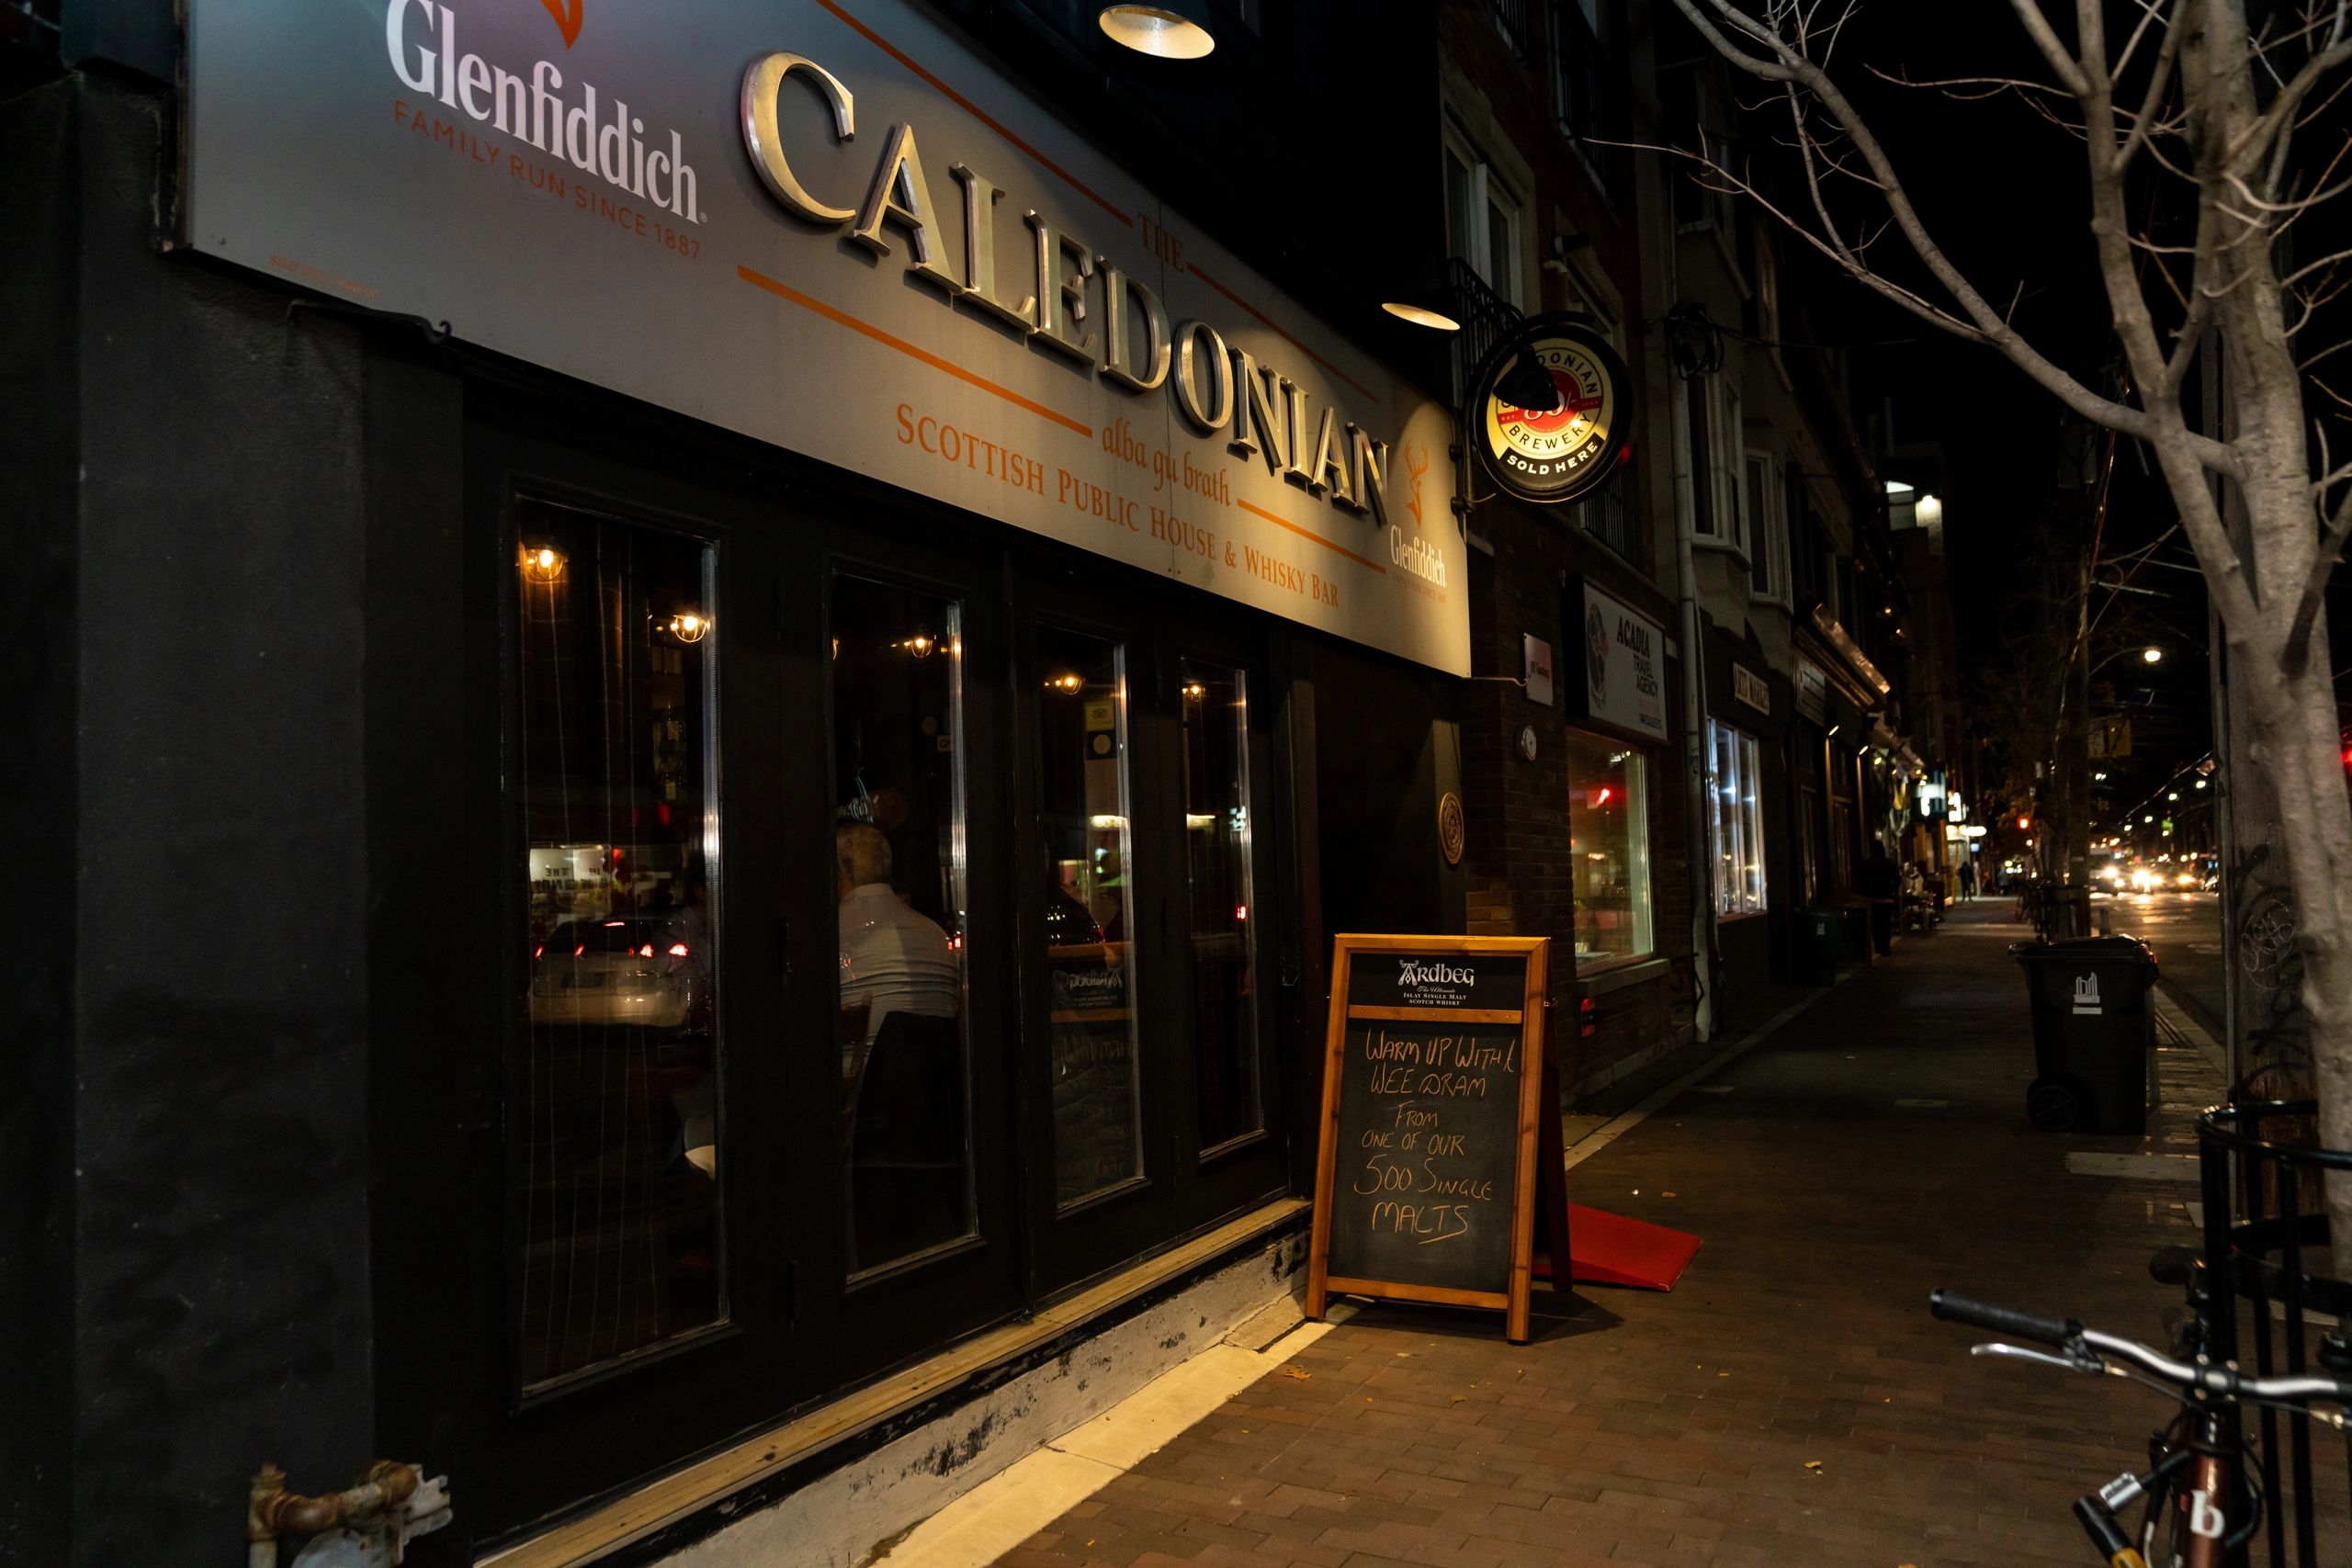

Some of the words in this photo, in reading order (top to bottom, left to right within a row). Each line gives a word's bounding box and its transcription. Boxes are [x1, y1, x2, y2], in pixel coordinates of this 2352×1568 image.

[386, 0, 700, 225] Glenfiddich
[393, 99, 501, 167] FAMILY
[510, 154, 565, 199] RUN
[574, 186, 648, 237] SINCE
[653, 223, 702, 260] 1887
[1137, 211, 1185, 274] THE
[741, 51, 1390, 521] CALEDONIAN
[1509, 413, 1592, 450] BREWERY
[1102, 416, 1148, 470] alba
[1153, 449, 1180, 492] gu
[1183, 450, 1232, 507] brath
[1507, 454, 1550, 475] SOLD
[1555, 441, 1600, 473] HERE
[896, 402, 1046, 497] SCOTTISH
[1057, 468, 1140, 533] PUBLIC
[1148, 504, 1216, 560] HOUSE
[1224, 539, 1238, 569] &
[1243, 544, 1306, 595] WHISKY
[1311, 572, 1340, 609] BAR
[1389, 524, 1447, 589] Glenfiddich
[1616, 615, 1651, 660] ACADIA
[1397, 958, 1476, 987] Ardbeg
[1365, 1028, 1420, 1064] WARM
[1425, 1036, 1453, 1066] UP
[1454, 1033, 1502, 1070] WITH
[1371, 1062, 1415, 1095] WEE
[1419, 1072, 1487, 1098] DRAM
[1395, 1100, 1439, 1128] FROM
[1362, 1129, 1395, 1148] ONE
[1401, 1131, 1422, 1150] OF
[1428, 1134, 1465, 1156] OUR
[1353, 1153, 1412, 1195] 500
[1418, 1157, 1493, 1201] SINGLE
[1372, 1201, 1470, 1245] MALTS
